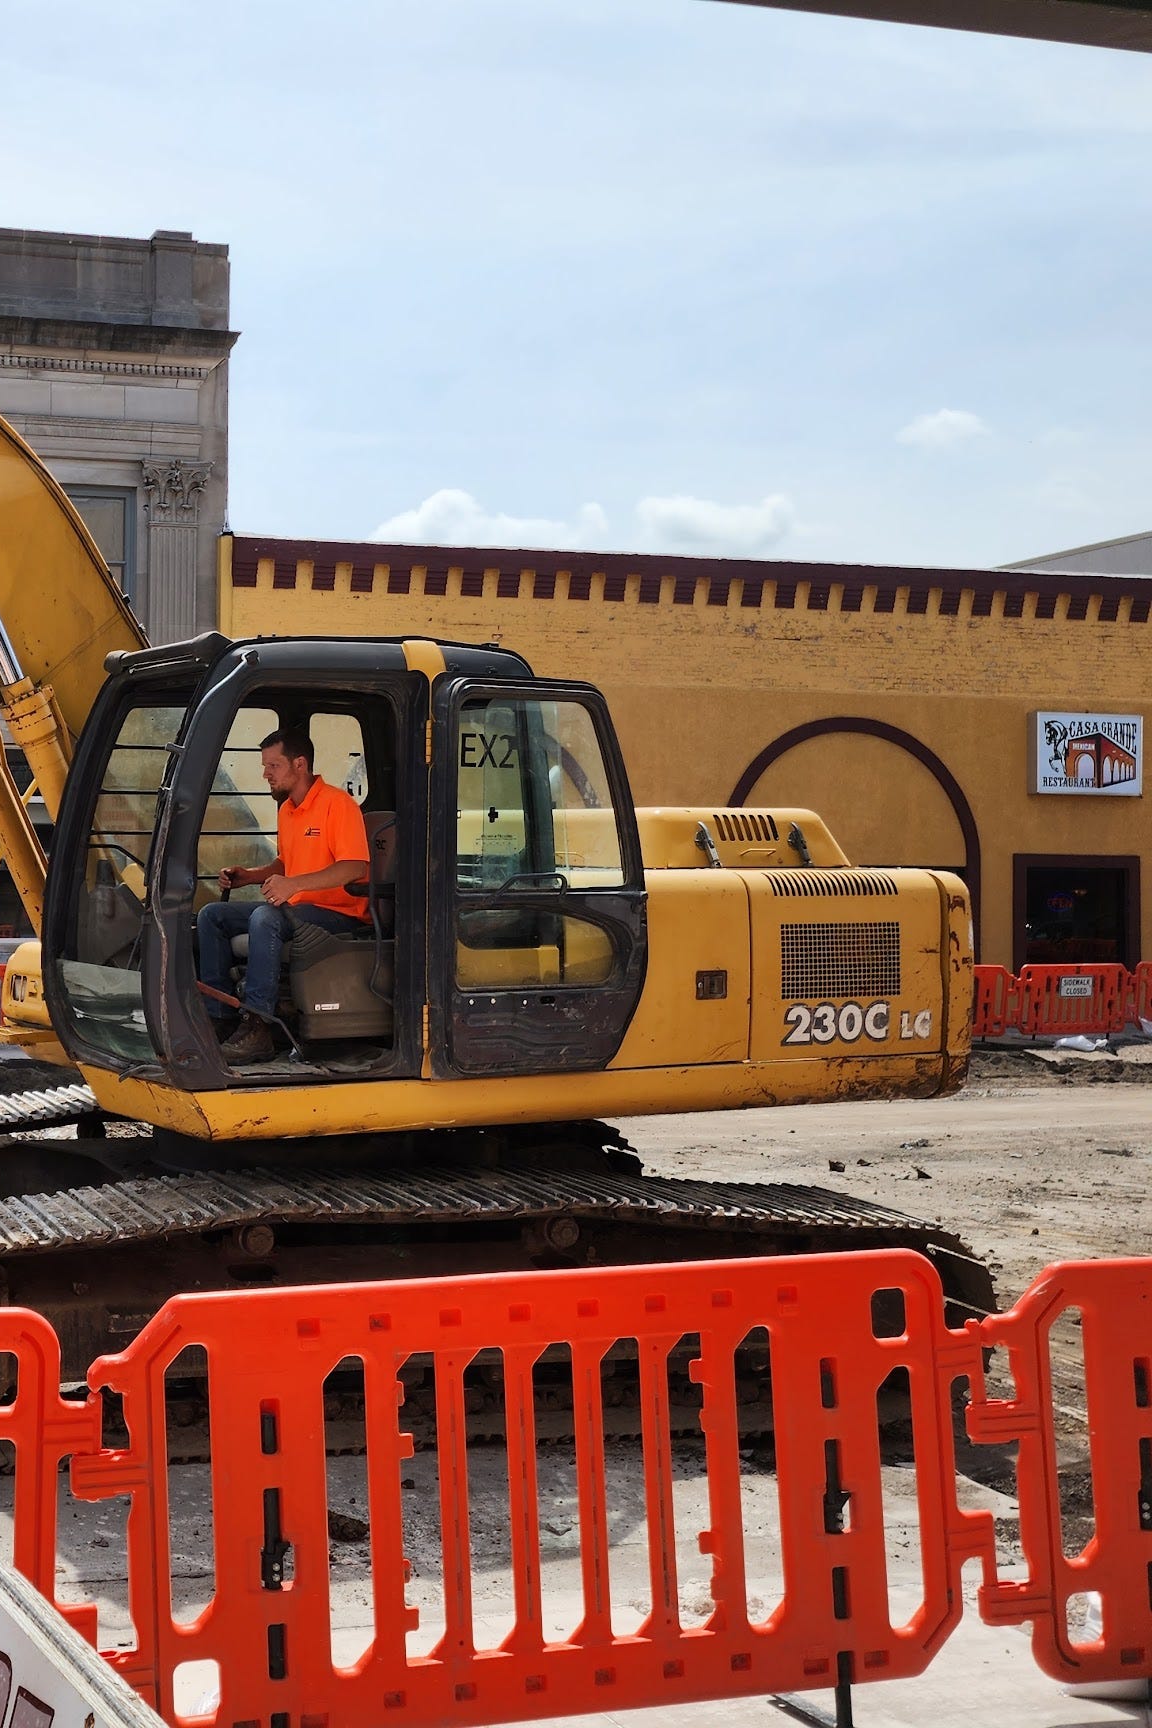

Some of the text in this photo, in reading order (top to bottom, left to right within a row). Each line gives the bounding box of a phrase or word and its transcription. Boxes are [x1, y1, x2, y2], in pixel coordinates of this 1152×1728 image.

[1069, 721, 1137, 754] CASA GRANDE
[1072, 742, 1096, 751] MEXICAN
[460, 733, 515, 768] EX2
[1043, 776, 1096, 788] RESTAURANT
[1066, 987, 1088, 995] CLOSED
[783, 1001, 889, 1045] 230C
